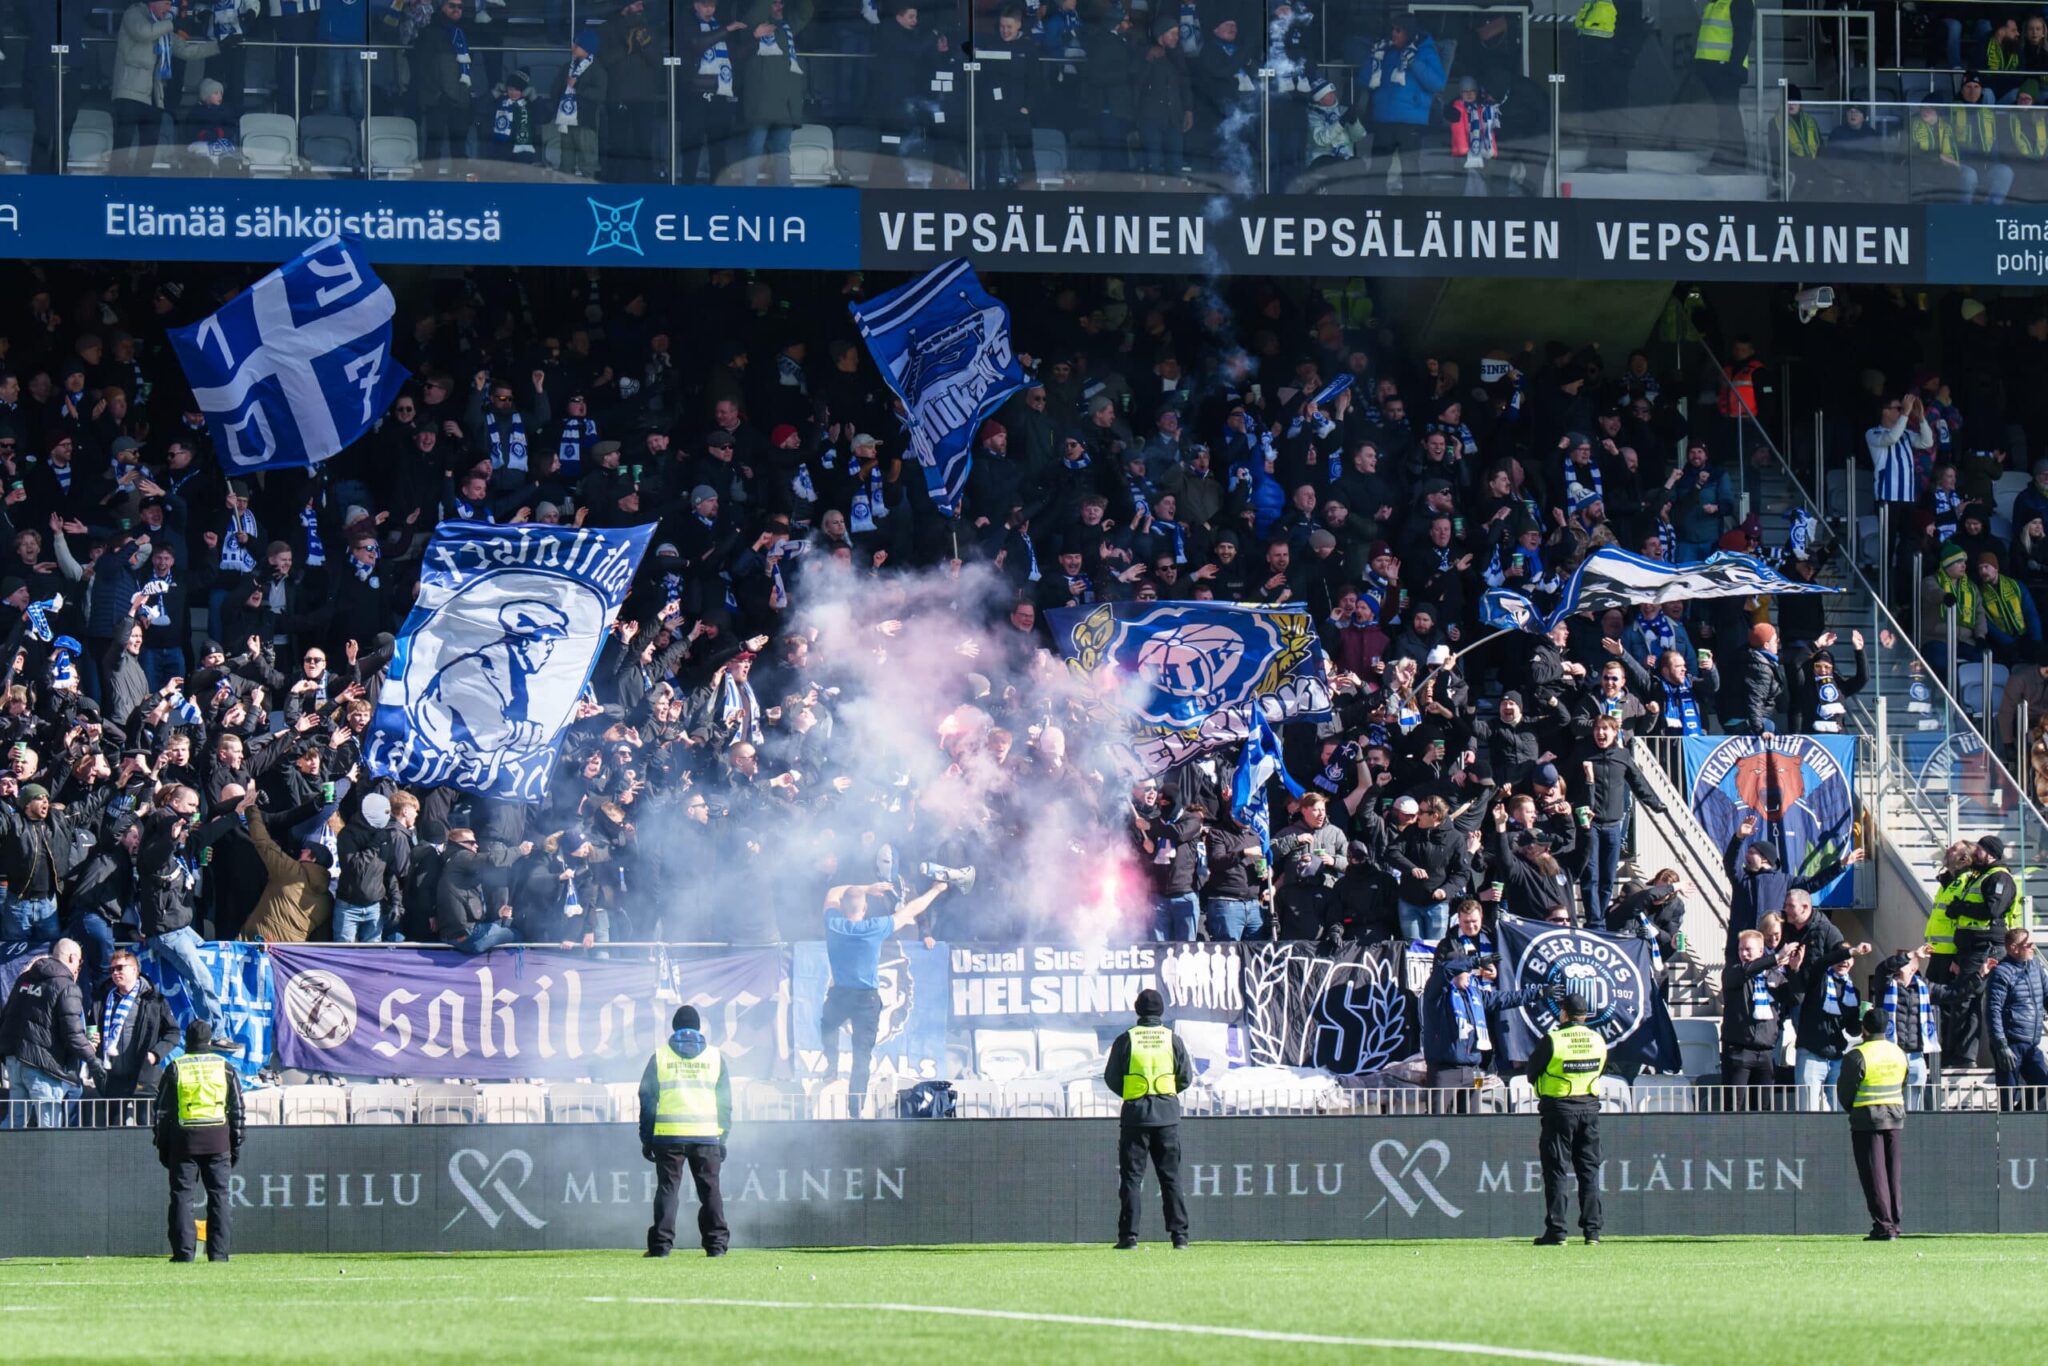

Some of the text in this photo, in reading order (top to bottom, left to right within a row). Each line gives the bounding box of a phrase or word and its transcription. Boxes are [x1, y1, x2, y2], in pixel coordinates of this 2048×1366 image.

[106, 203, 500, 241] Elämää sähköistämässä
[655, 214, 806, 243] ELENIA
[879, 205, 1204, 256] VEPSÄLÄINEN
[1240, 210, 1559, 260] VEPSÄLÄINEN
[1595, 215, 1910, 265] VEPSÄLÄINEN
[1701, 736, 1755, 787] HELSINKI
[1803, 745, 1838, 782] FIRM
[952, 945, 1155, 974] Usual Susects
[1528, 938, 1632, 983] BEER BOYS
[1612, 989, 1634, 1000] 1907
[193, 1173, 423, 1208] RHEILU
[1116, 1162, 1346, 1198] HEILU
